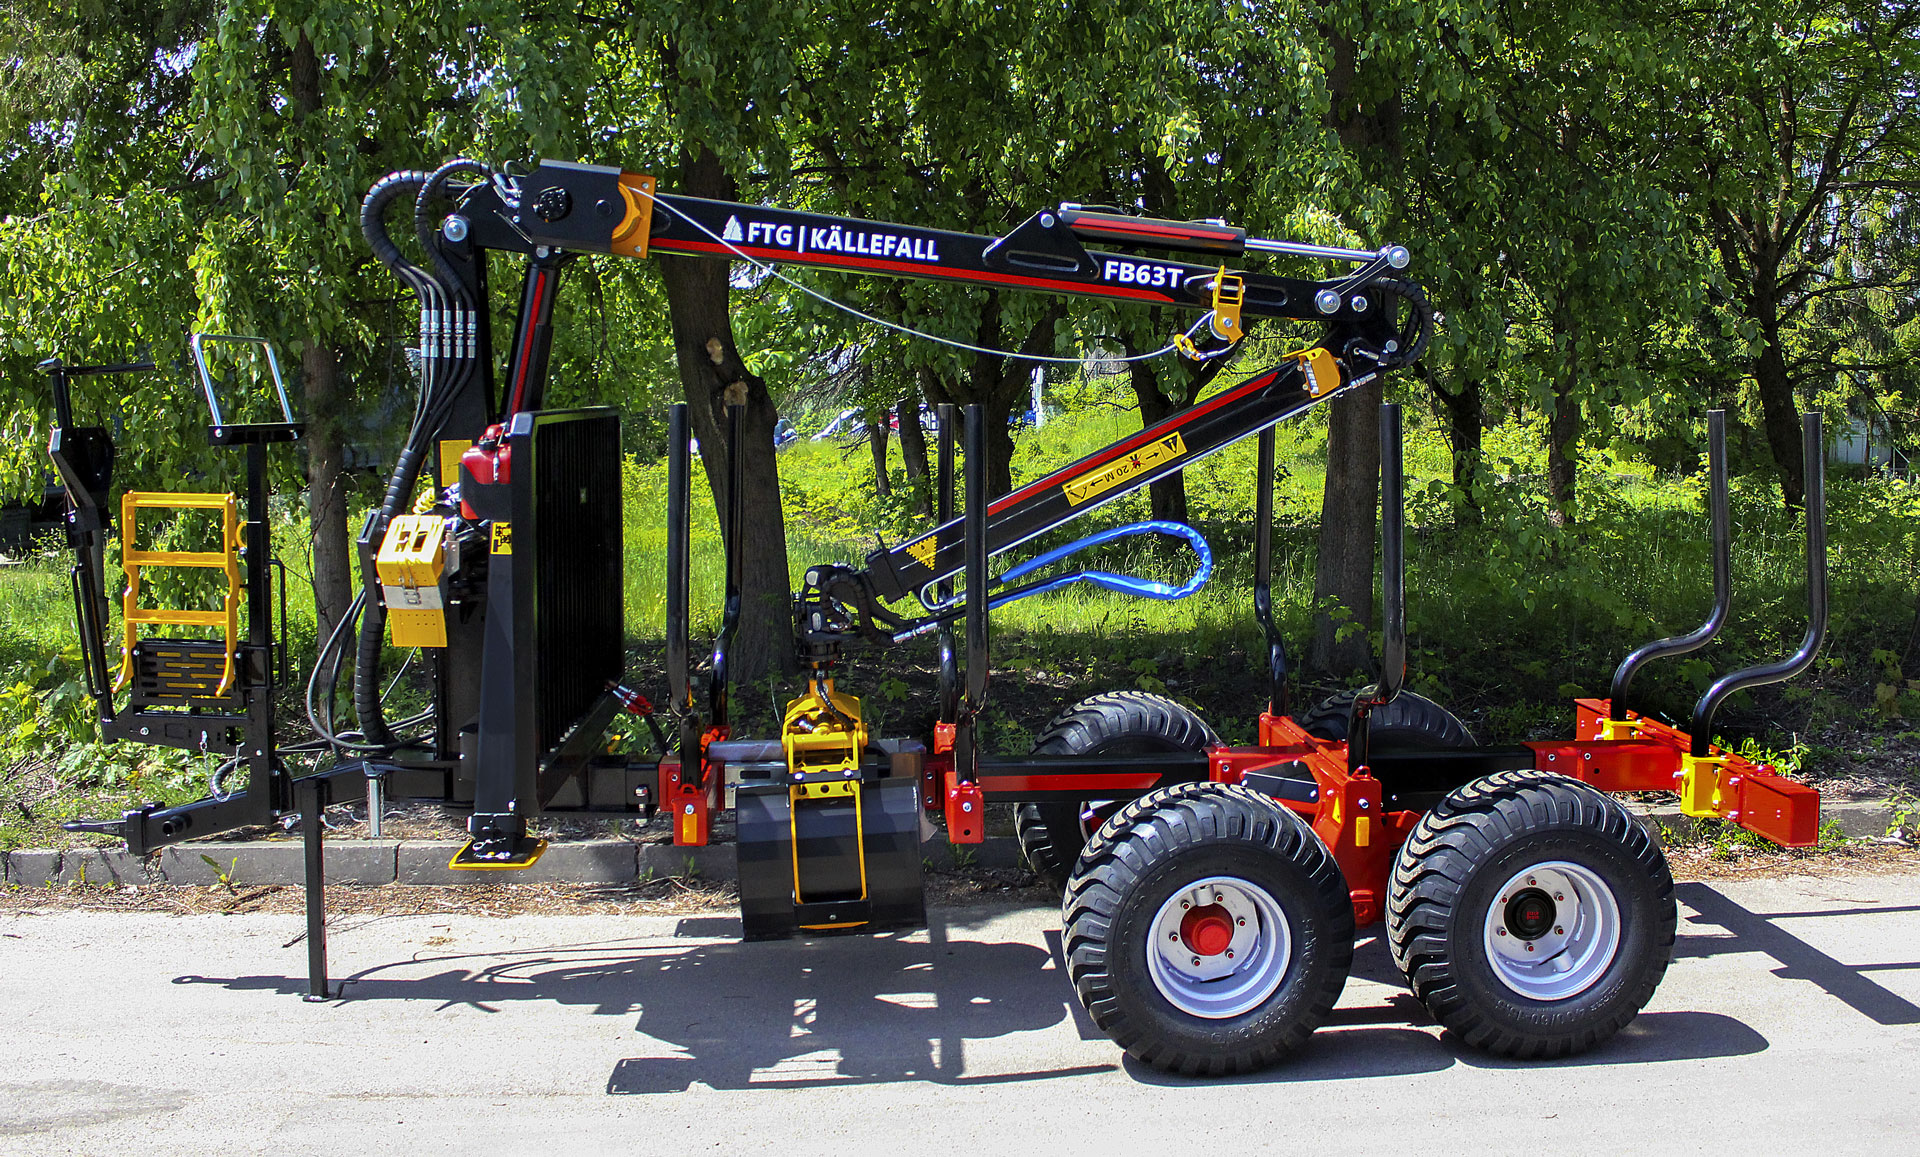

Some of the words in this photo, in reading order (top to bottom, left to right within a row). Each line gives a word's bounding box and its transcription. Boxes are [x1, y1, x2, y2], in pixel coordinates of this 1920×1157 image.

[747, 222, 792, 246] FTG
[811, 225, 939, 261] KÄLLEFALL
[1104, 260, 1184, 288] FB63T
[1103, 472, 1115, 482] M
[1116, 464, 1130, 477] 20
